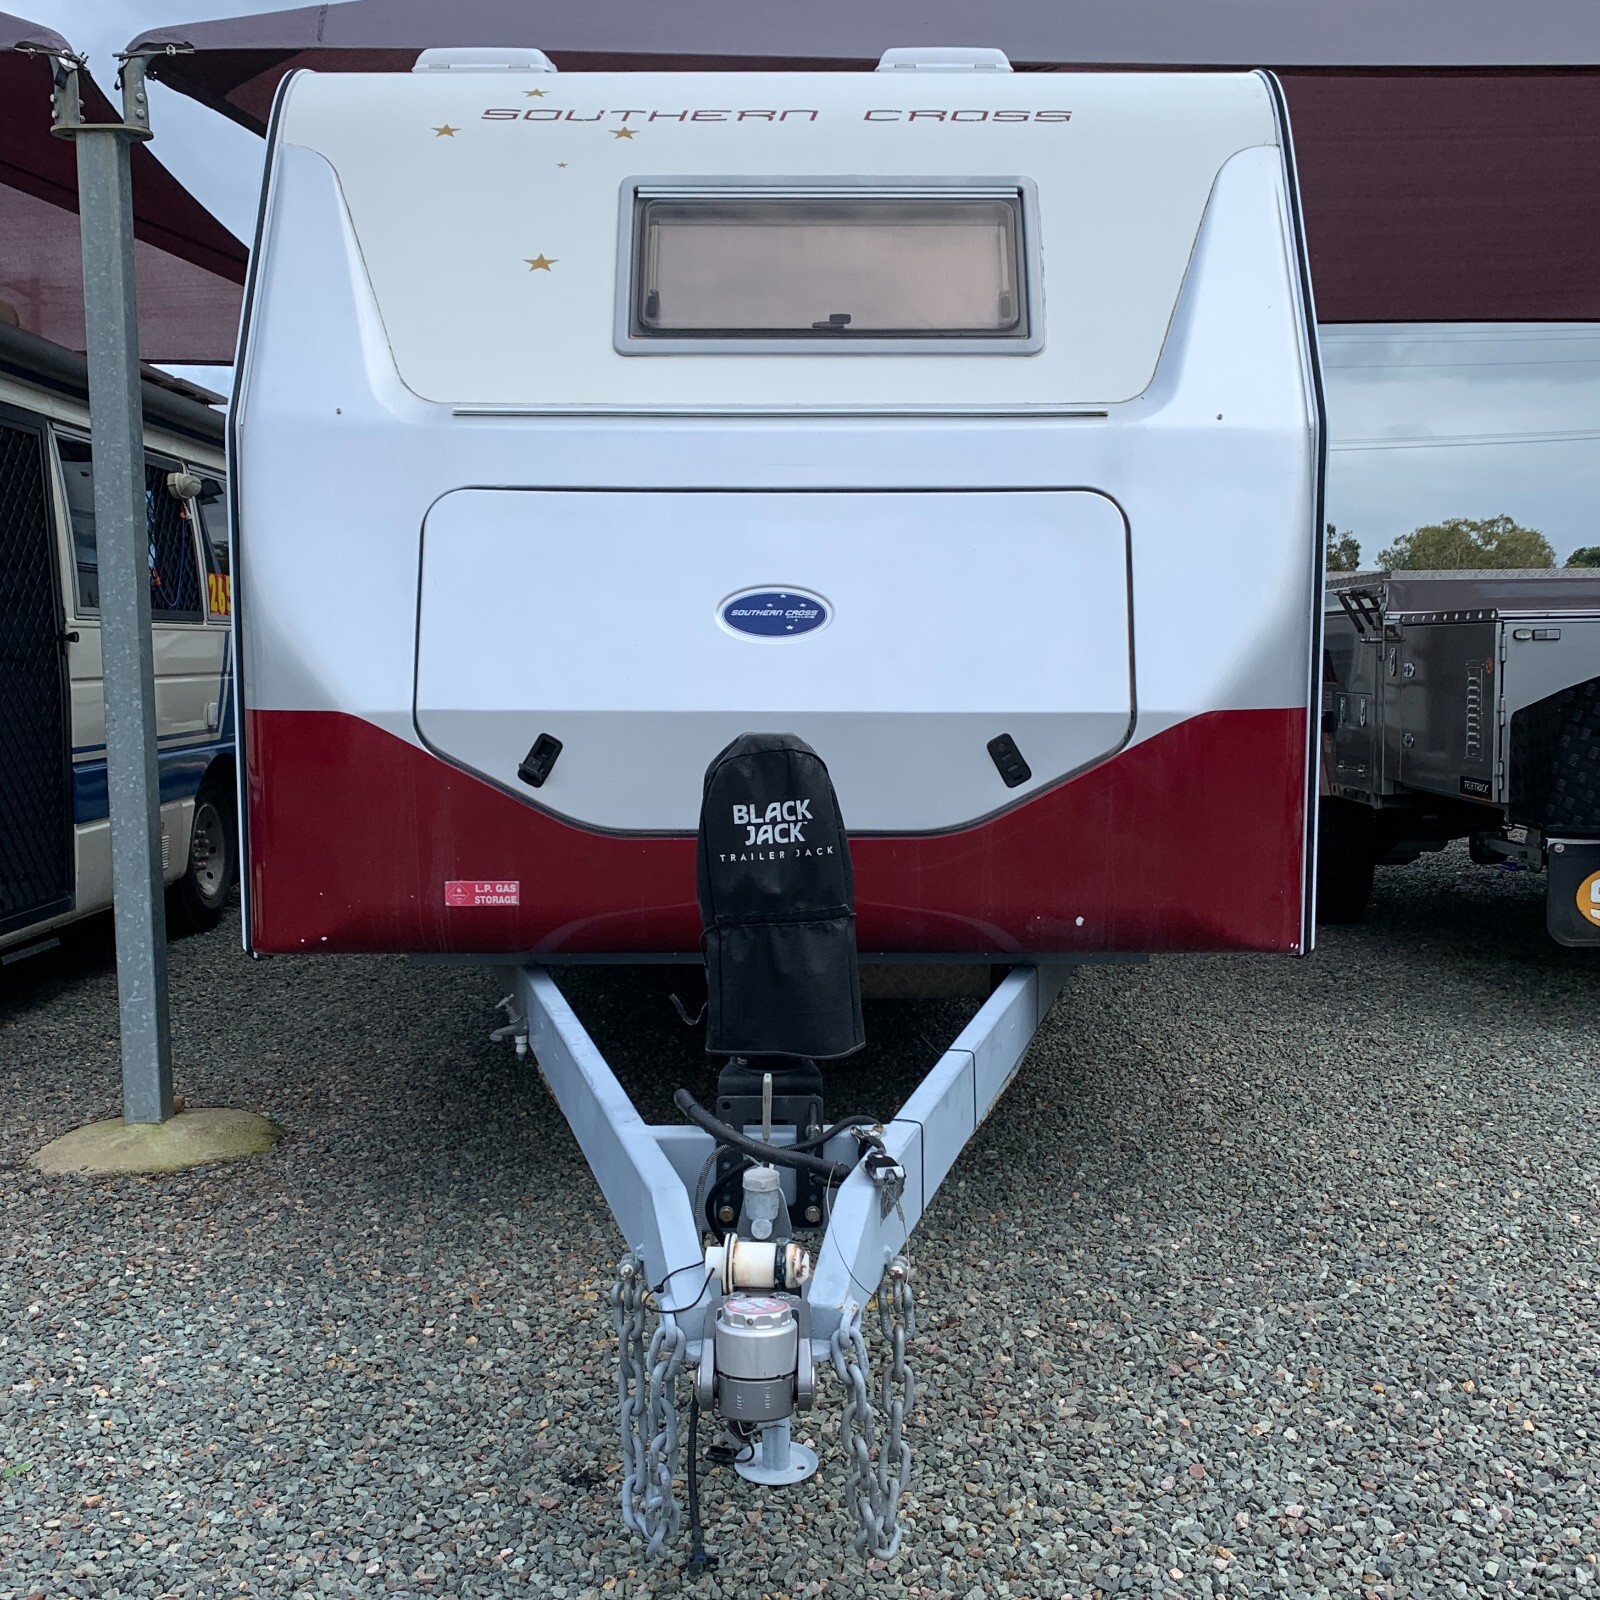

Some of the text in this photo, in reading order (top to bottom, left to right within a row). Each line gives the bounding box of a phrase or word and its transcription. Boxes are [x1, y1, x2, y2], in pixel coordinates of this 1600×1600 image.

[481, 108, 1073, 122] SOUTHERN CROSS
[732, 799, 813, 825] BLACK
[745, 823, 806, 845] JACK
[719, 846, 834, 862] TRAILER JACK
[475, 884, 516, 893] L.P. GAS
[475, 895, 517, 904] STORAGE
